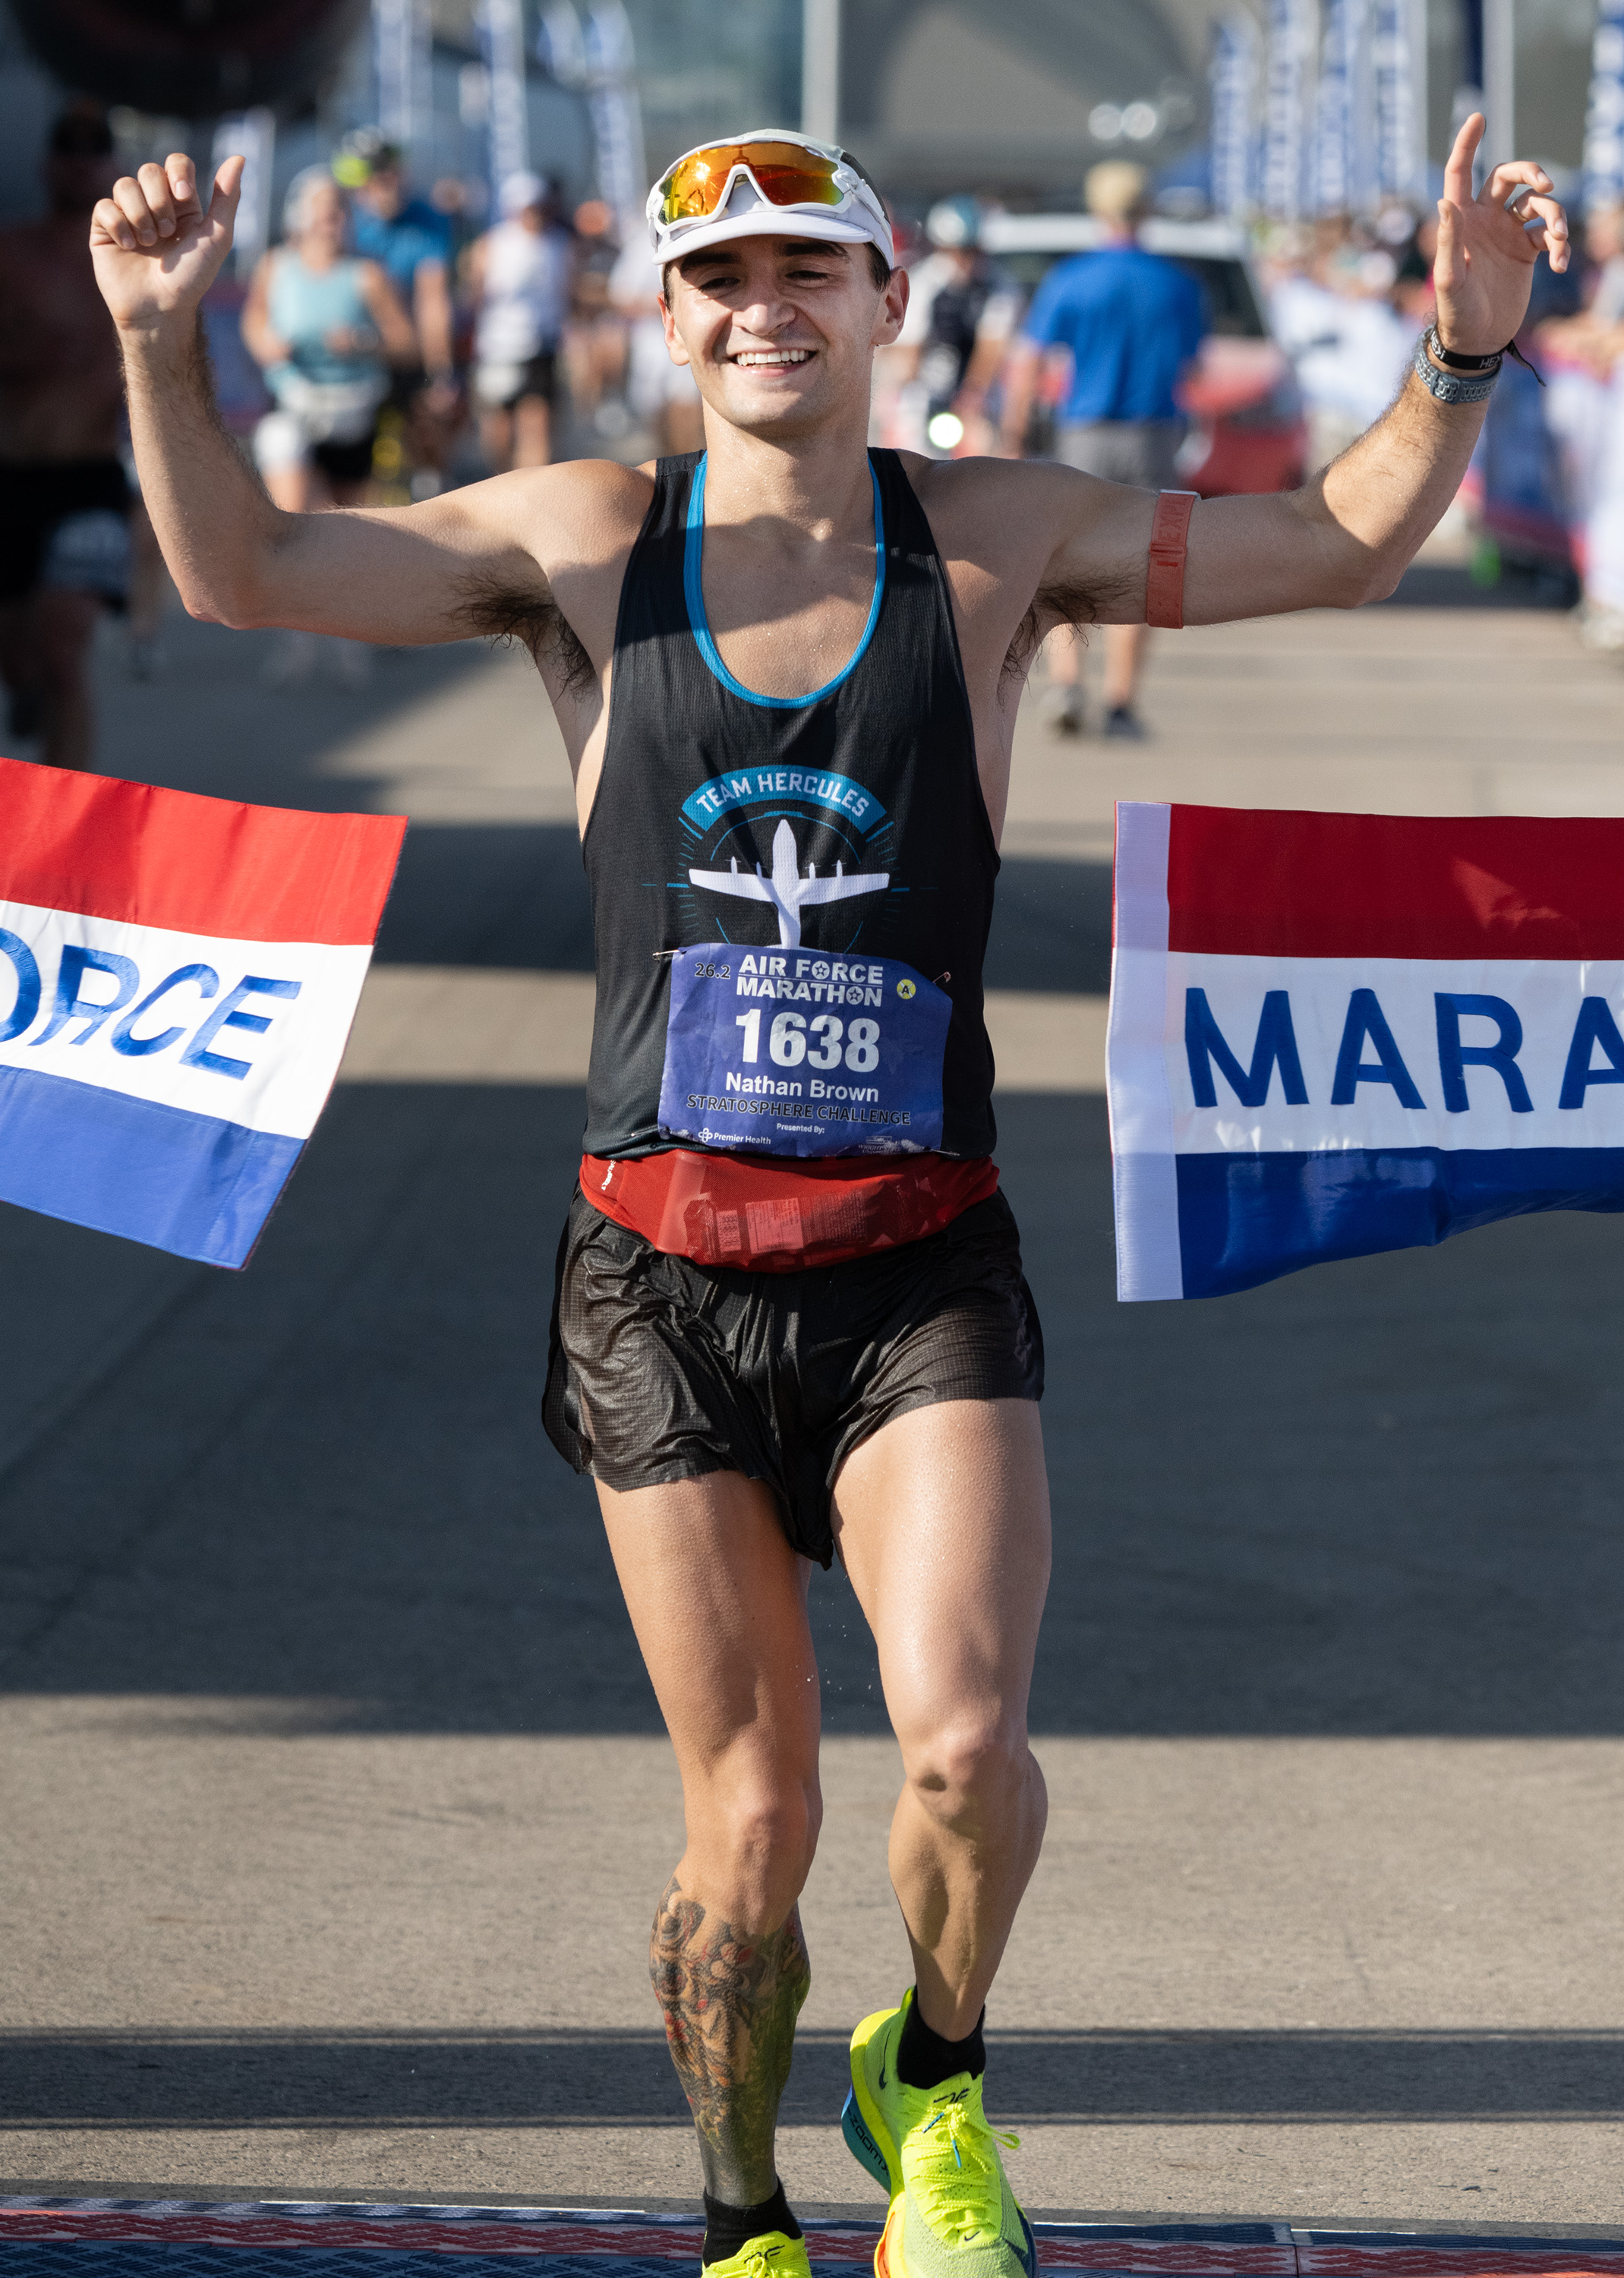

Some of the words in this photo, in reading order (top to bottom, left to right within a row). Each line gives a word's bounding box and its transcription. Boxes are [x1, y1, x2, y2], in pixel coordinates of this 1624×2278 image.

[696, 777, 752, 813] TEAM
[758, 772, 869, 818] HERCULES
[694, 962, 731, 980] 26.2
[739, 954, 787, 977] AIR
[795, 959, 884, 985] FORCE
[736, 976, 883, 1007] MARATHON
[901, 985, 910, 994] A
[735, 1008, 881, 1072] 1638
[1185, 987, 1624, 1113] MARA
[725, 1071, 803, 1096] Nathan
[809, 1079, 879, 1102] Brown
[686, 1094, 813, 1119] STRATOSPHERE
[817, 1106, 911, 1125] CHALLENGE
[714, 1132, 744, 1143] Premier
[745, 1136, 771, 1144] Health
[776, 1123, 812, 1132] Presented
[814, 1125, 825, 1134] By:
